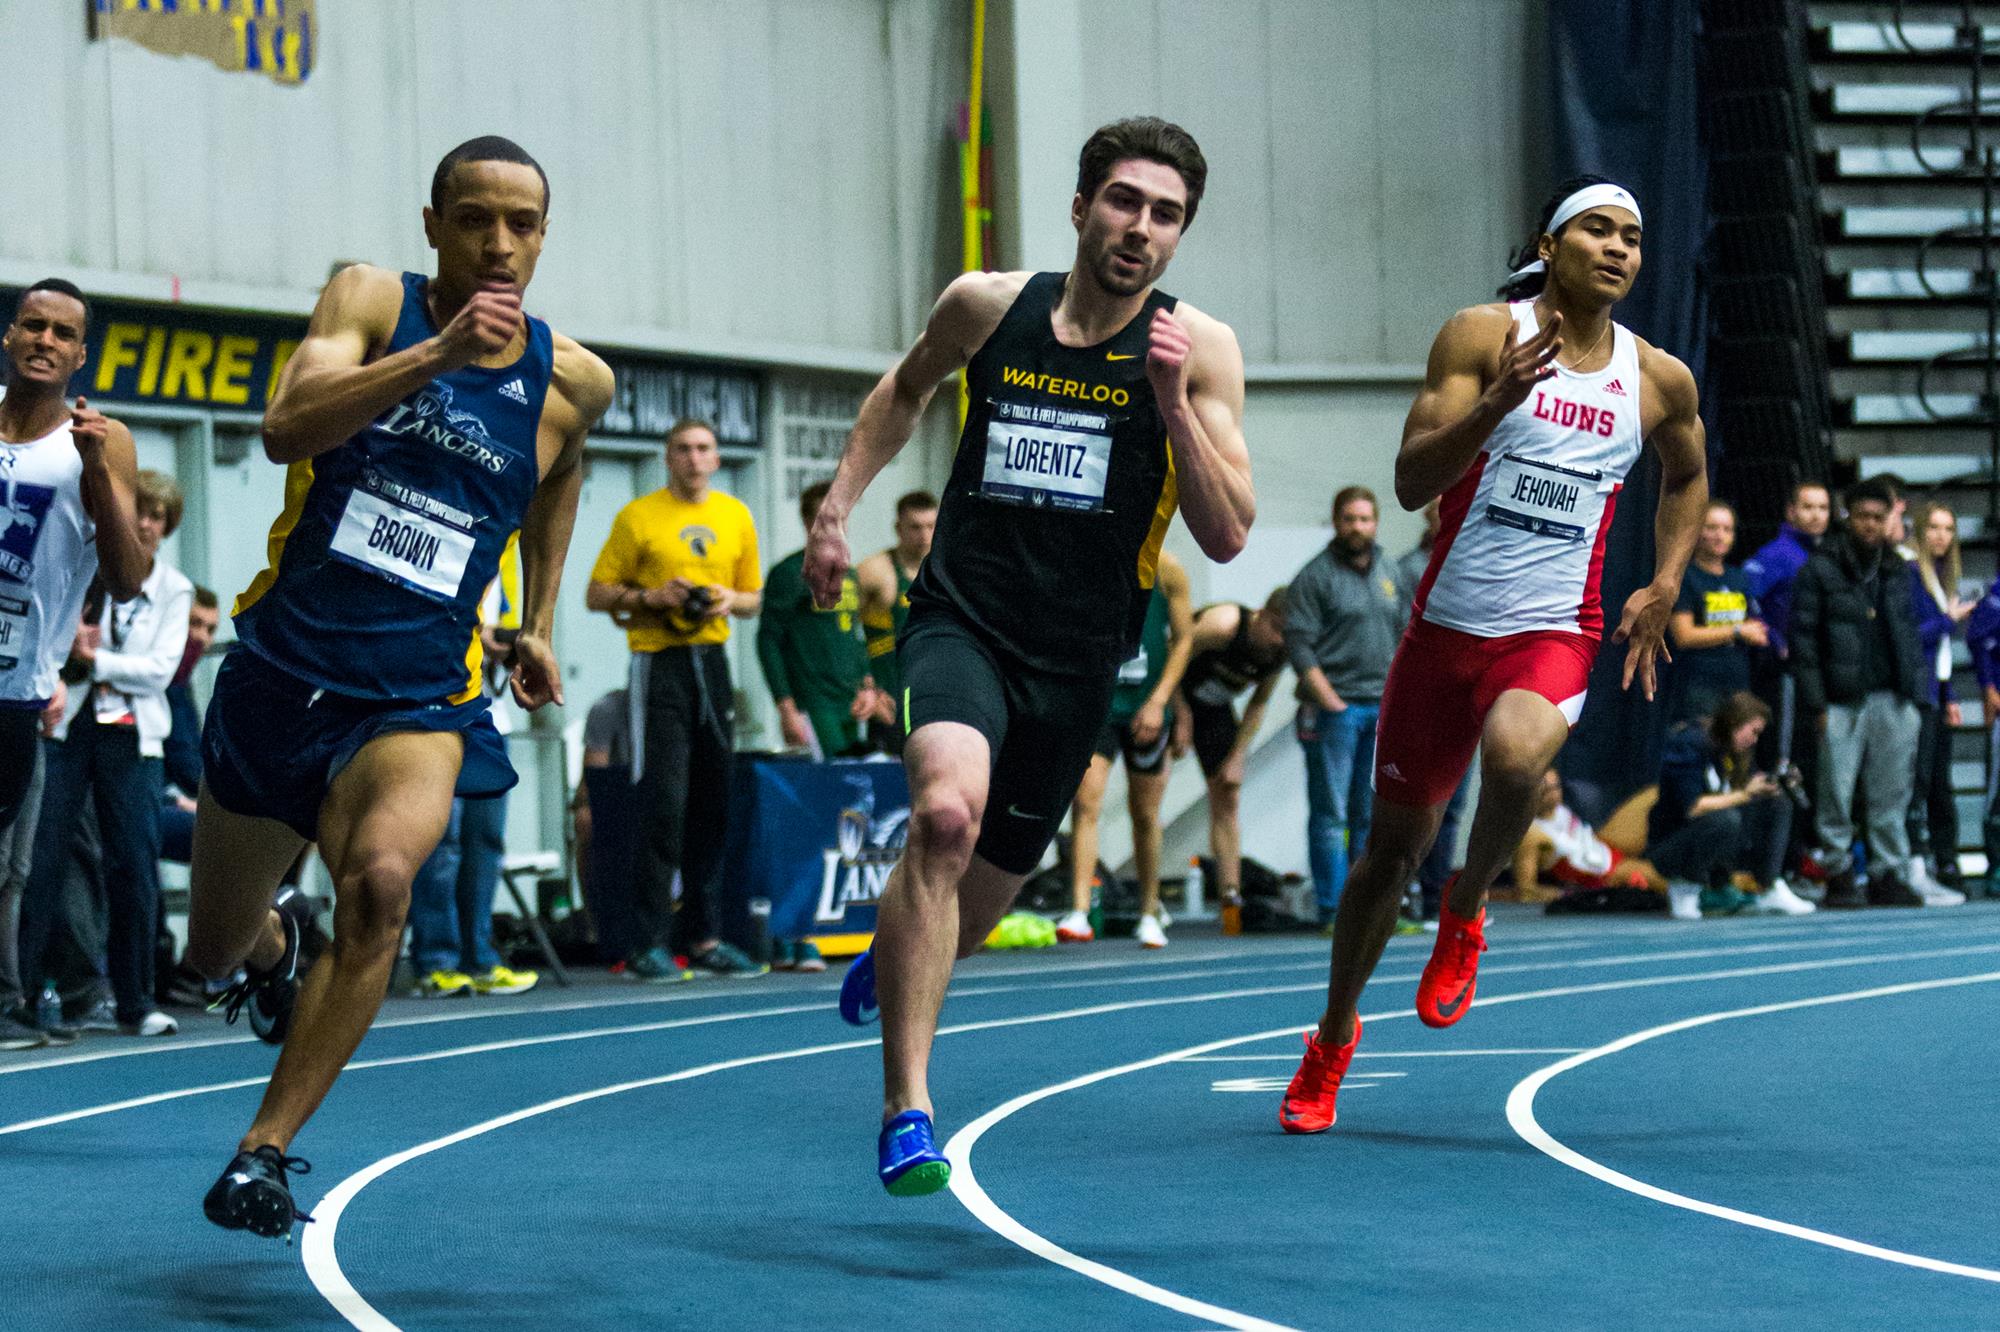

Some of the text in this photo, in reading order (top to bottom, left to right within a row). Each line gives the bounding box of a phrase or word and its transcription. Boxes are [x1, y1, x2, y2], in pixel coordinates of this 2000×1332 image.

[95, 322, 259, 405] FIRE
[1003, 366, 1129, 406] WATERLOO
[498, 387, 528, 405] adidas
[1533, 391, 1616, 438] LIONS
[373, 404, 505, 473] LANCERS
[1004, 436, 1087, 479] LORENTZ
[1510, 473, 1579, 513] JEHOVAH
[368, 514, 441, 572] BROWN
[815, 850, 895, 921] LAN
